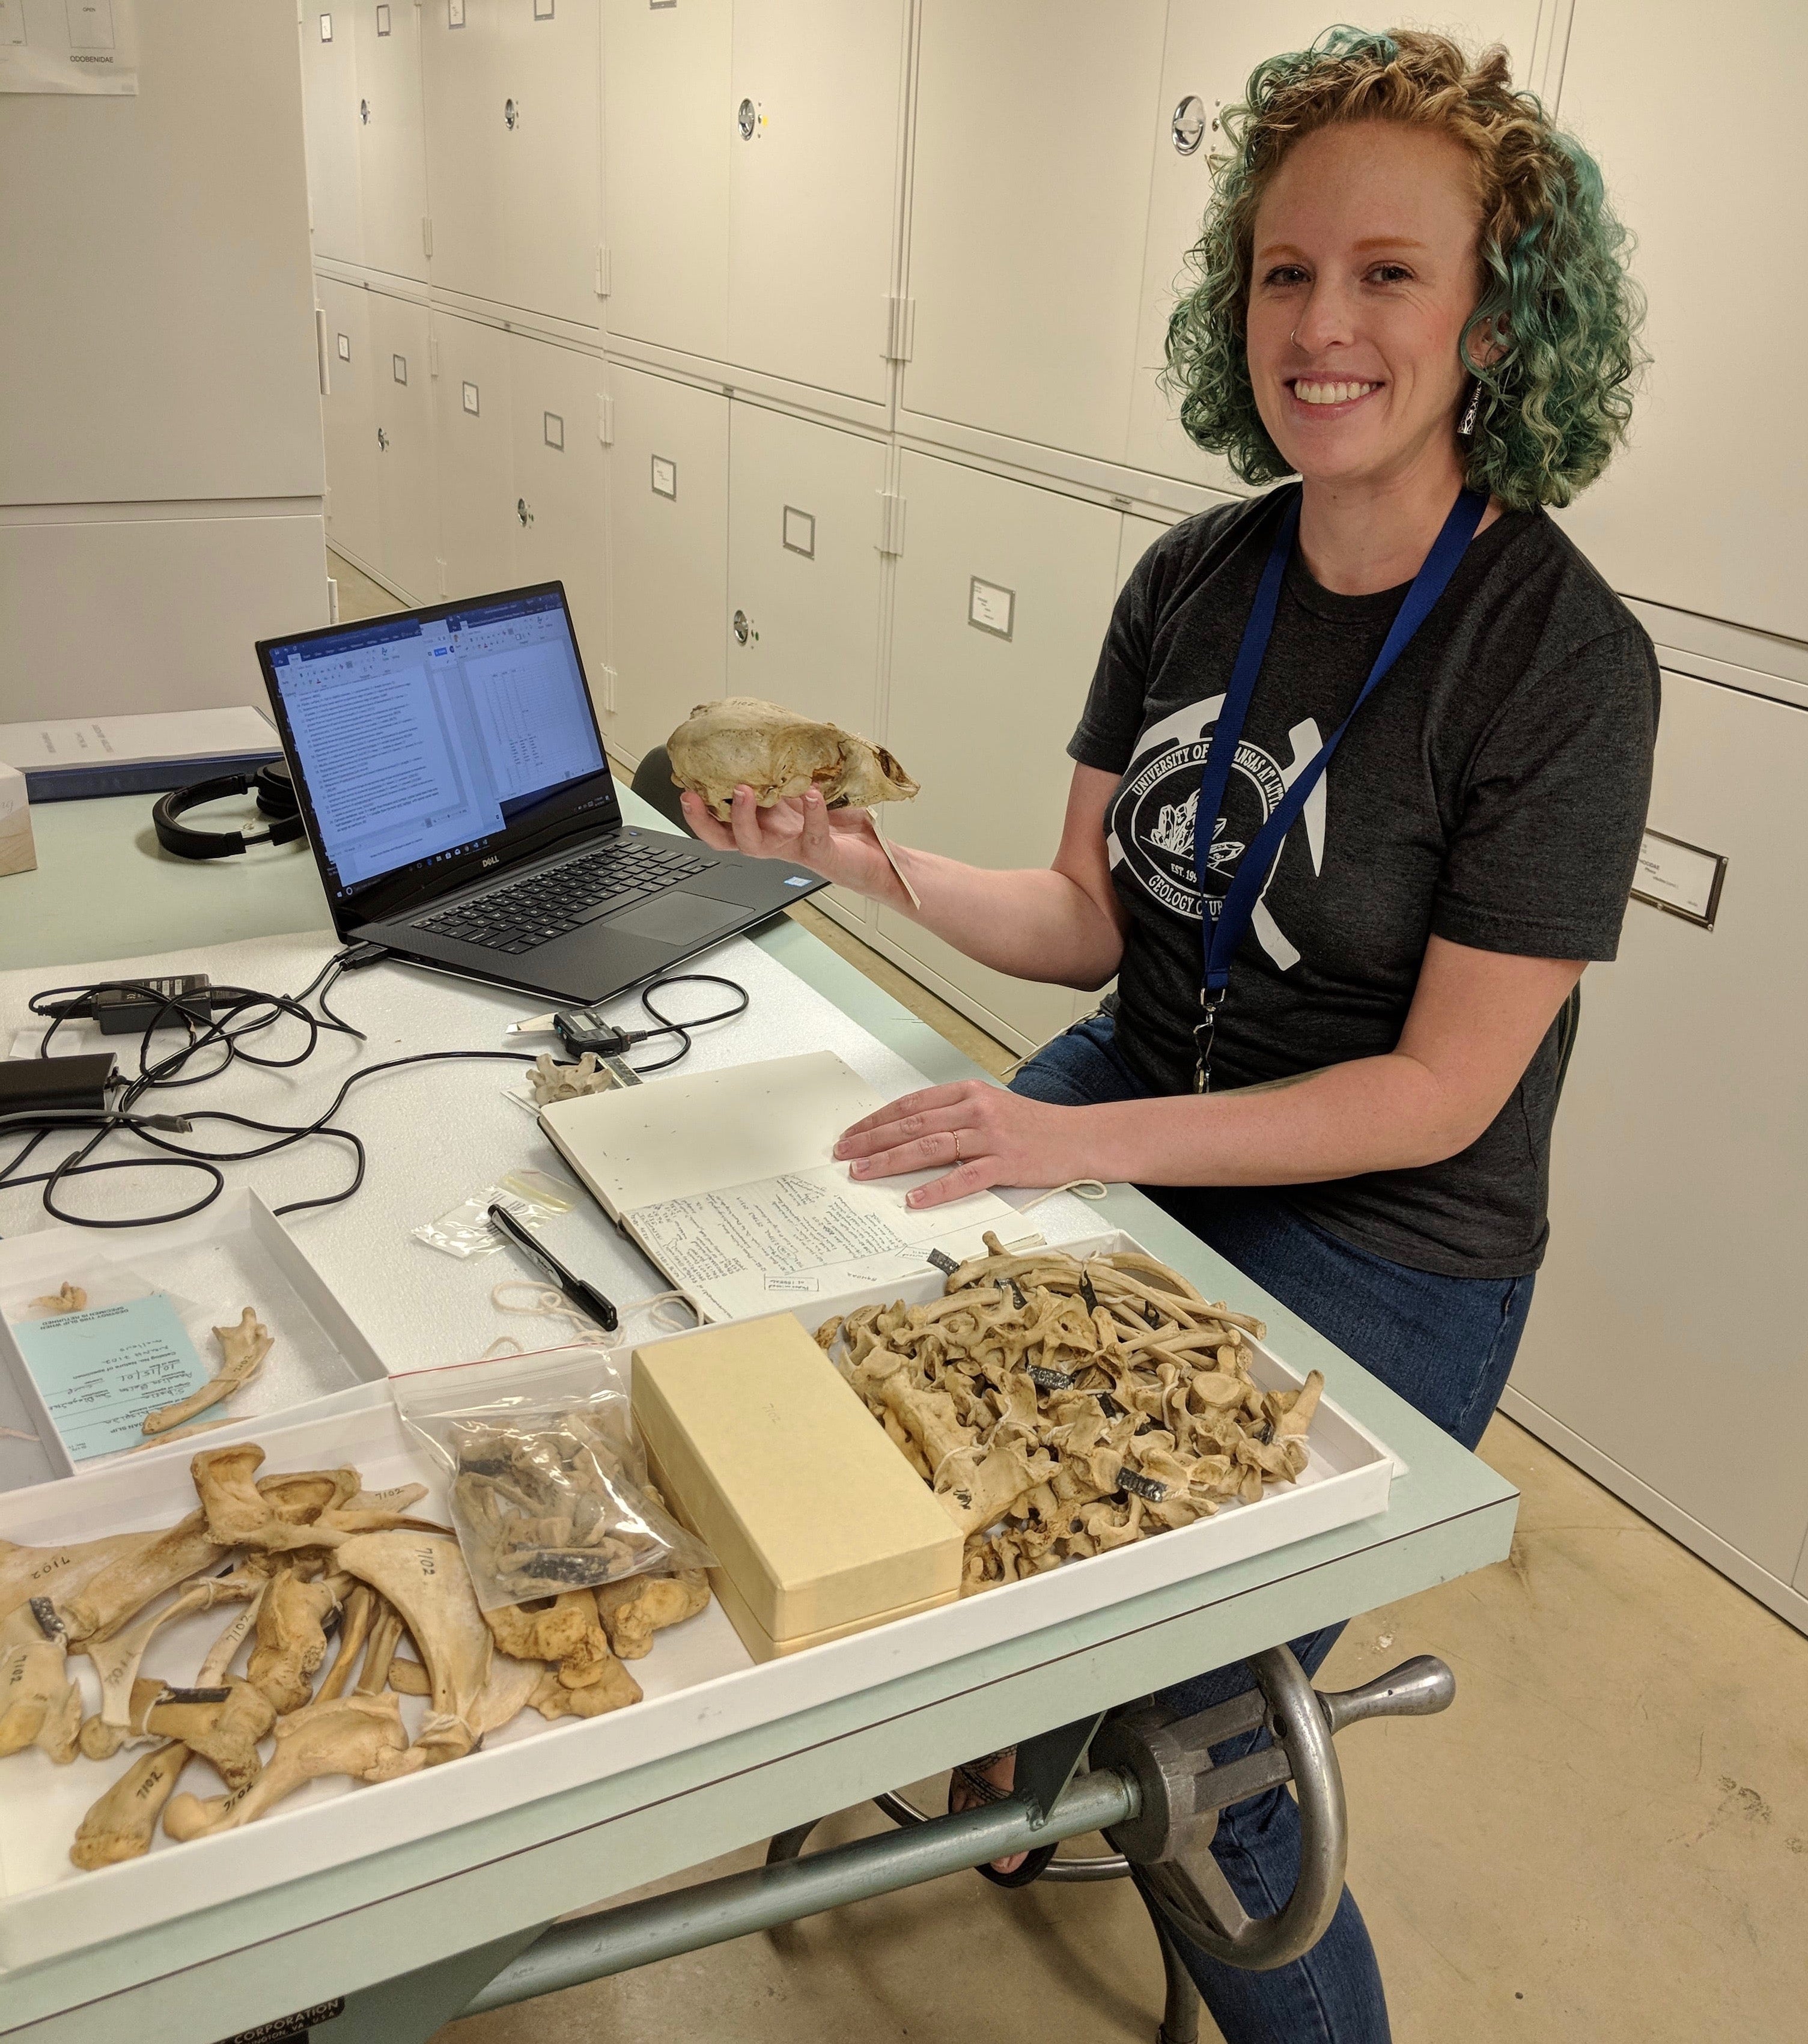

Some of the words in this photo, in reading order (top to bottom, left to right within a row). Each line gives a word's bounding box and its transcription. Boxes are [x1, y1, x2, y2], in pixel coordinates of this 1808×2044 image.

[1131, 747, 1190, 795] UNIVERSITY
[1192, 744, 1210, 759] OF
[1233, 747, 1267, 773] ANSAS
[1256, 765, 1276, 783] AT
[482, 855, 499, 868] DELL
[1170, 863, 1185, 878] EST.
[1148, 874, 1195, 912] GEOLOGY
[1196, 900, 1223, 916] CUB
[42, 1316, 80, 1325] RETURNED
[91, 1306, 124, 1316] SPECIMEN
[97, 1309, 129, 1318] DESTROY
[121, 1361, 174, 1381] 10/15/01
[375, 1488, 404, 1500] 7102
[31, 1556, 70, 1580] 7102
[415, 1547, 436, 1575] 7102
[226, 1614, 253, 1642] 7102
[9, 1655, 27, 1686] 7102
[136, 1771, 165, 1799] 7102
[224, 1780, 254, 1811] 7102
[234, 1998, 338, 2043] CORPORATION
